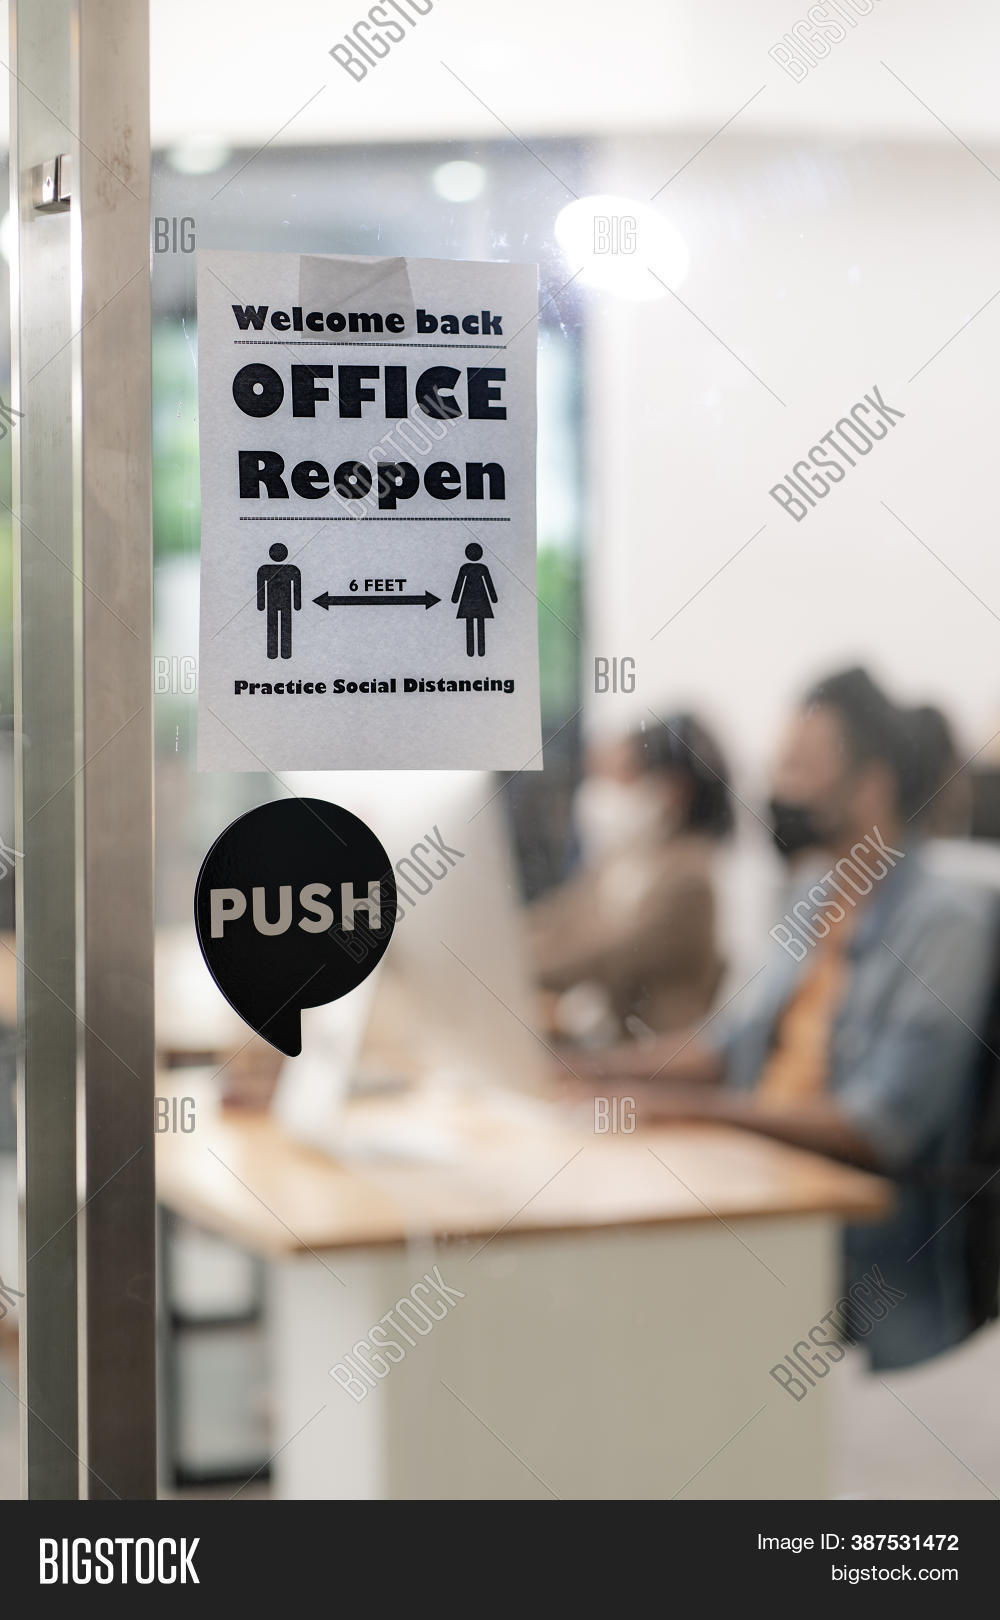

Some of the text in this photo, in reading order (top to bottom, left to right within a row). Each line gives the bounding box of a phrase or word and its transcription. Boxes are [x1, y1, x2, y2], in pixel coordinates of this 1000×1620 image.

[231, 305, 503, 335] Welcome back
[232, 363, 507, 420] OFFICE
[238, 450, 506, 510] Reopen
[349, 579, 407, 592] 6 FEET
[234, 677, 515, 695] Practice Social Distancing
[210, 881, 382, 939] PUSH
